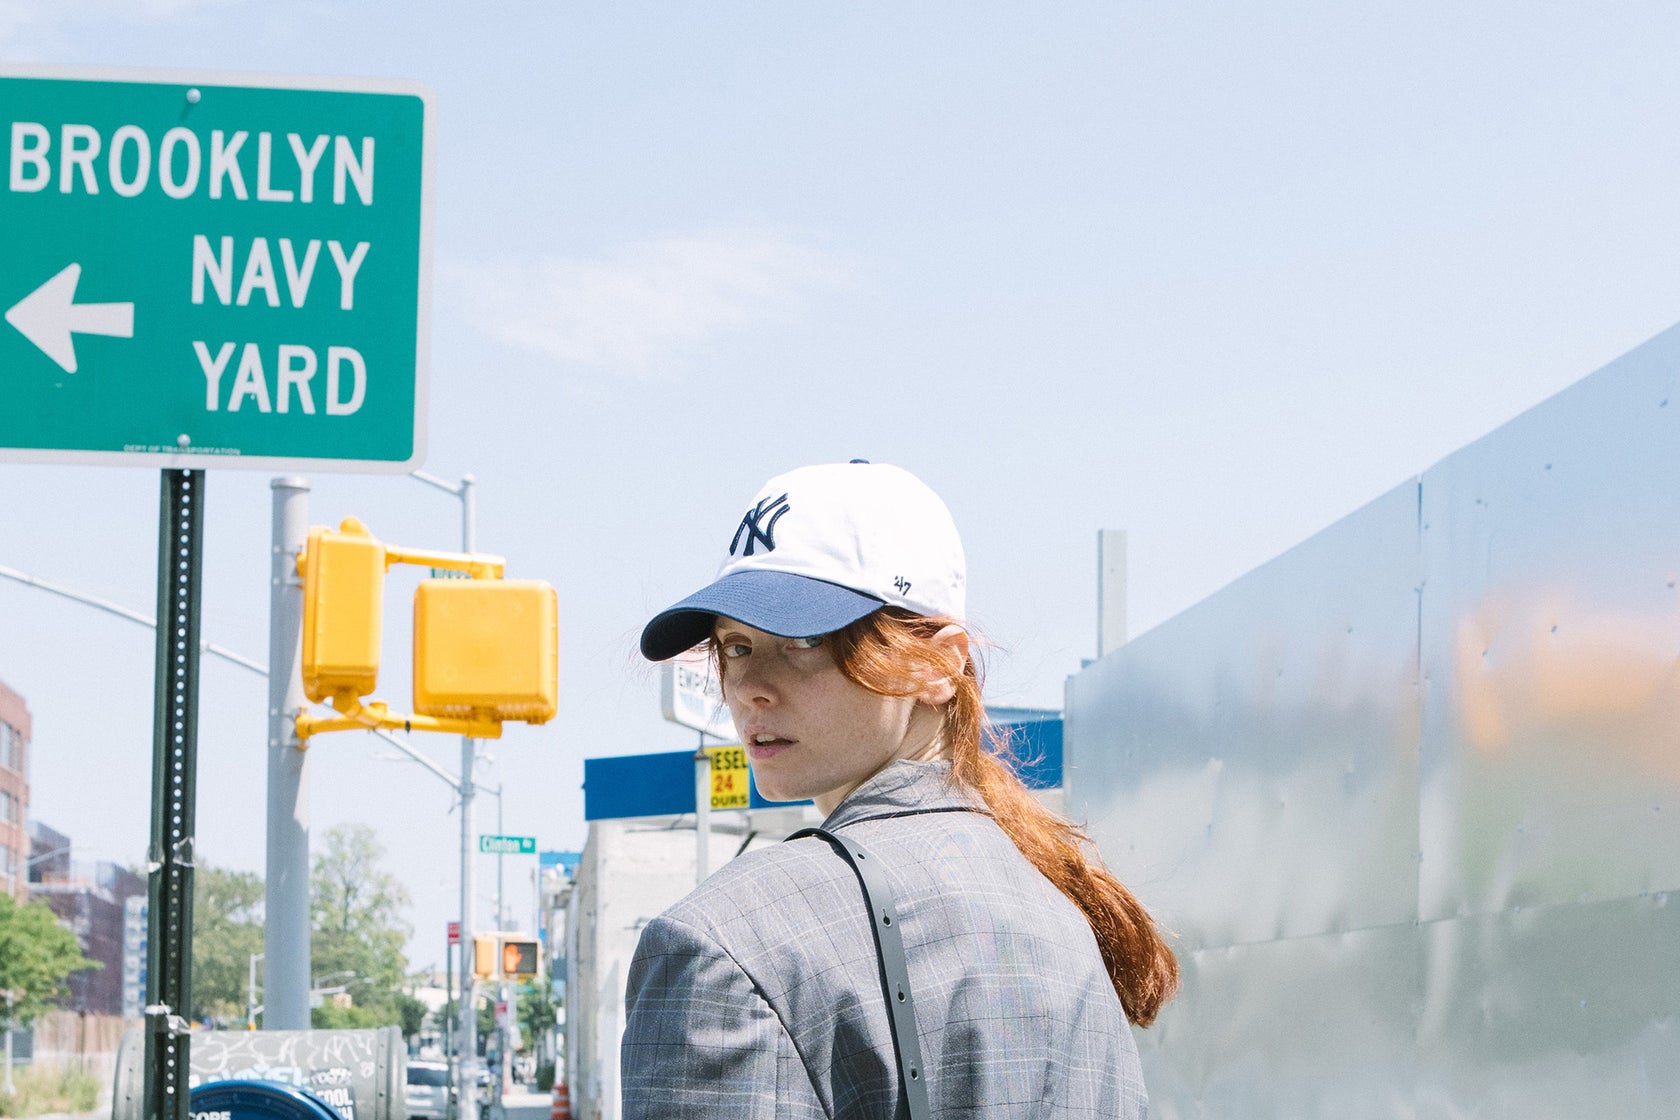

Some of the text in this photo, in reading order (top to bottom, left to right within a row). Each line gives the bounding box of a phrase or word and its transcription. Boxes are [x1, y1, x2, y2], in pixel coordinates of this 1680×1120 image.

[9, 121, 375, 206] BROOKLYN
[191, 234, 371, 311] NAVY
[192, 340, 368, 417] YARD
[729, 492, 790, 556] NY
[712, 750, 748, 770] ESEL
[714, 773, 733, 793] 24
[711, 795, 748, 807] OURS
